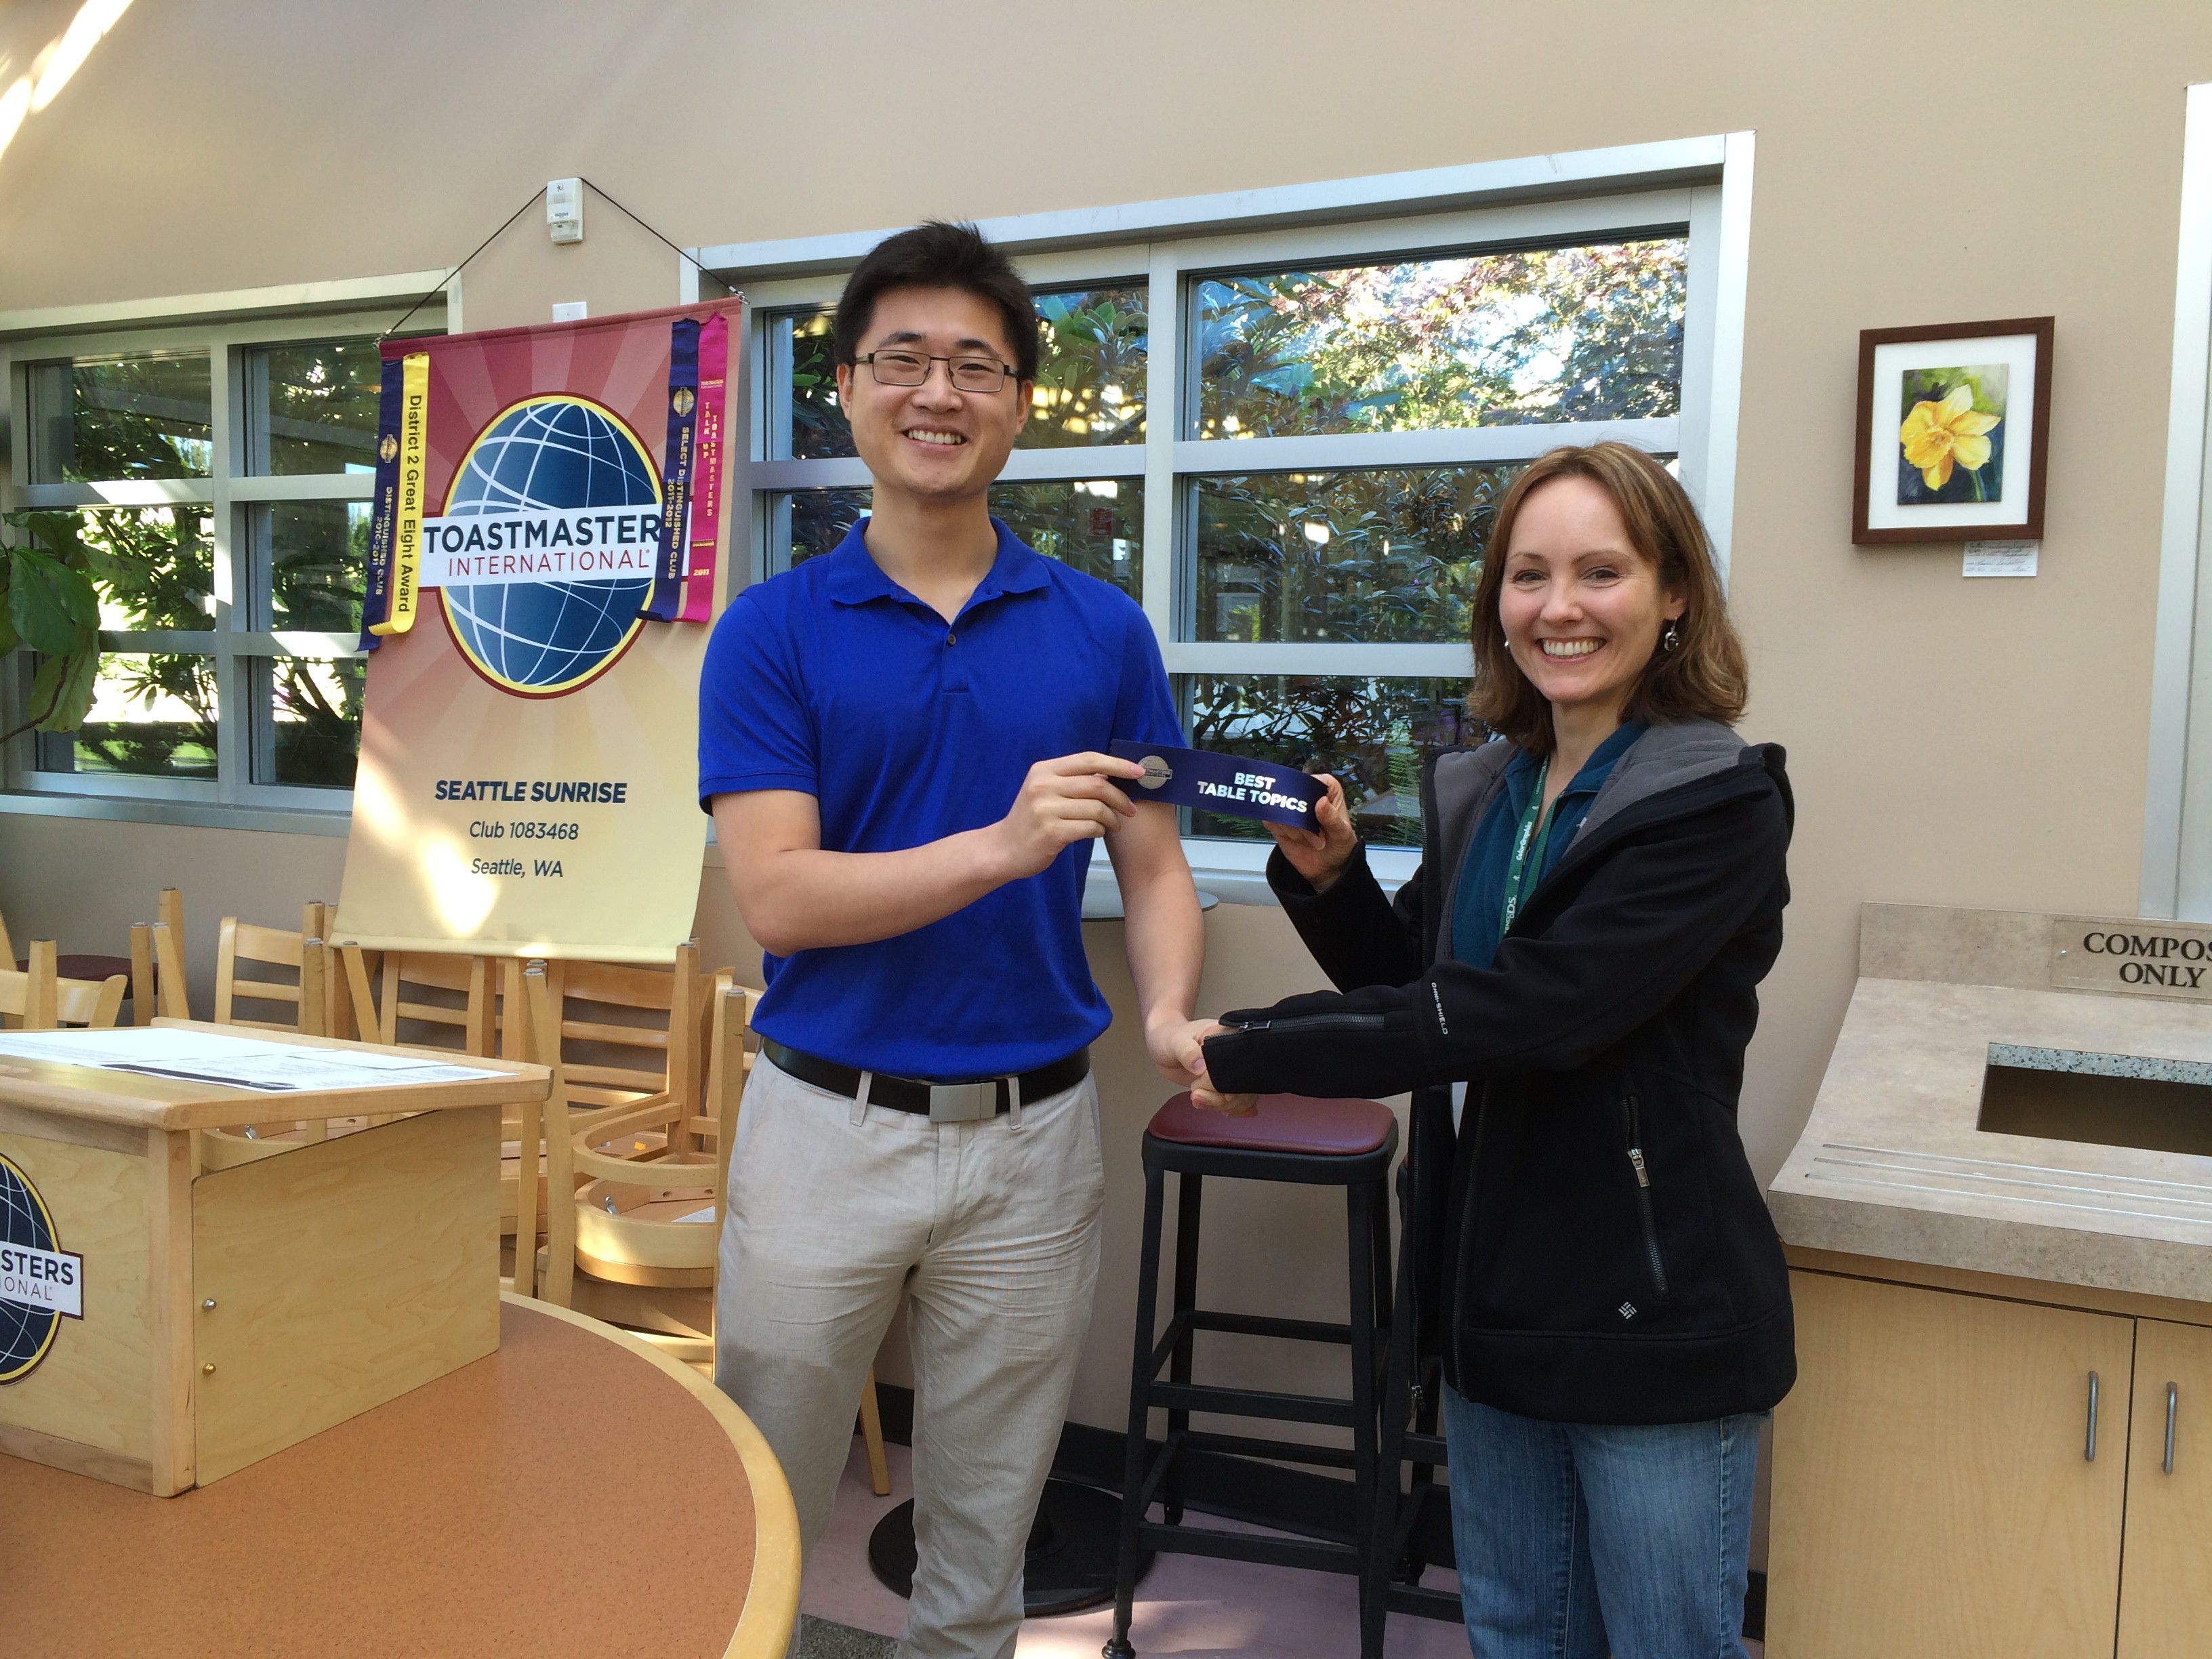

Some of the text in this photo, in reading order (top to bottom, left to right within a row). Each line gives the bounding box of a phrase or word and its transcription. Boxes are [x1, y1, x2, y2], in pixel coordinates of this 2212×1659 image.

[679, 426, 690, 467] SELECT
[703, 443, 710, 459] UP
[707, 415, 718, 516] TOASTMASTERS
[398, 394, 422, 612] District 2 Great Eight Award
[664, 478, 676, 528] 2011-2012
[671, 469, 687, 550] DISTINGUISHED
[375, 486, 393, 596] DISTINGUISHED CLUB
[449, 549, 649, 576] INTERNATIONAL
[668, 551, 678, 579] CLUB
[434, 779, 628, 804] SEATTLE SUNRISE
[1233, 772, 1276, 790] BEST
[1197, 781, 1309, 813] TABLE TOPICS
[469, 821, 579, 840] Club 1083468
[470, 857, 564, 878] Seattle, WA
[2119, 962, 2207, 988] ONLY
